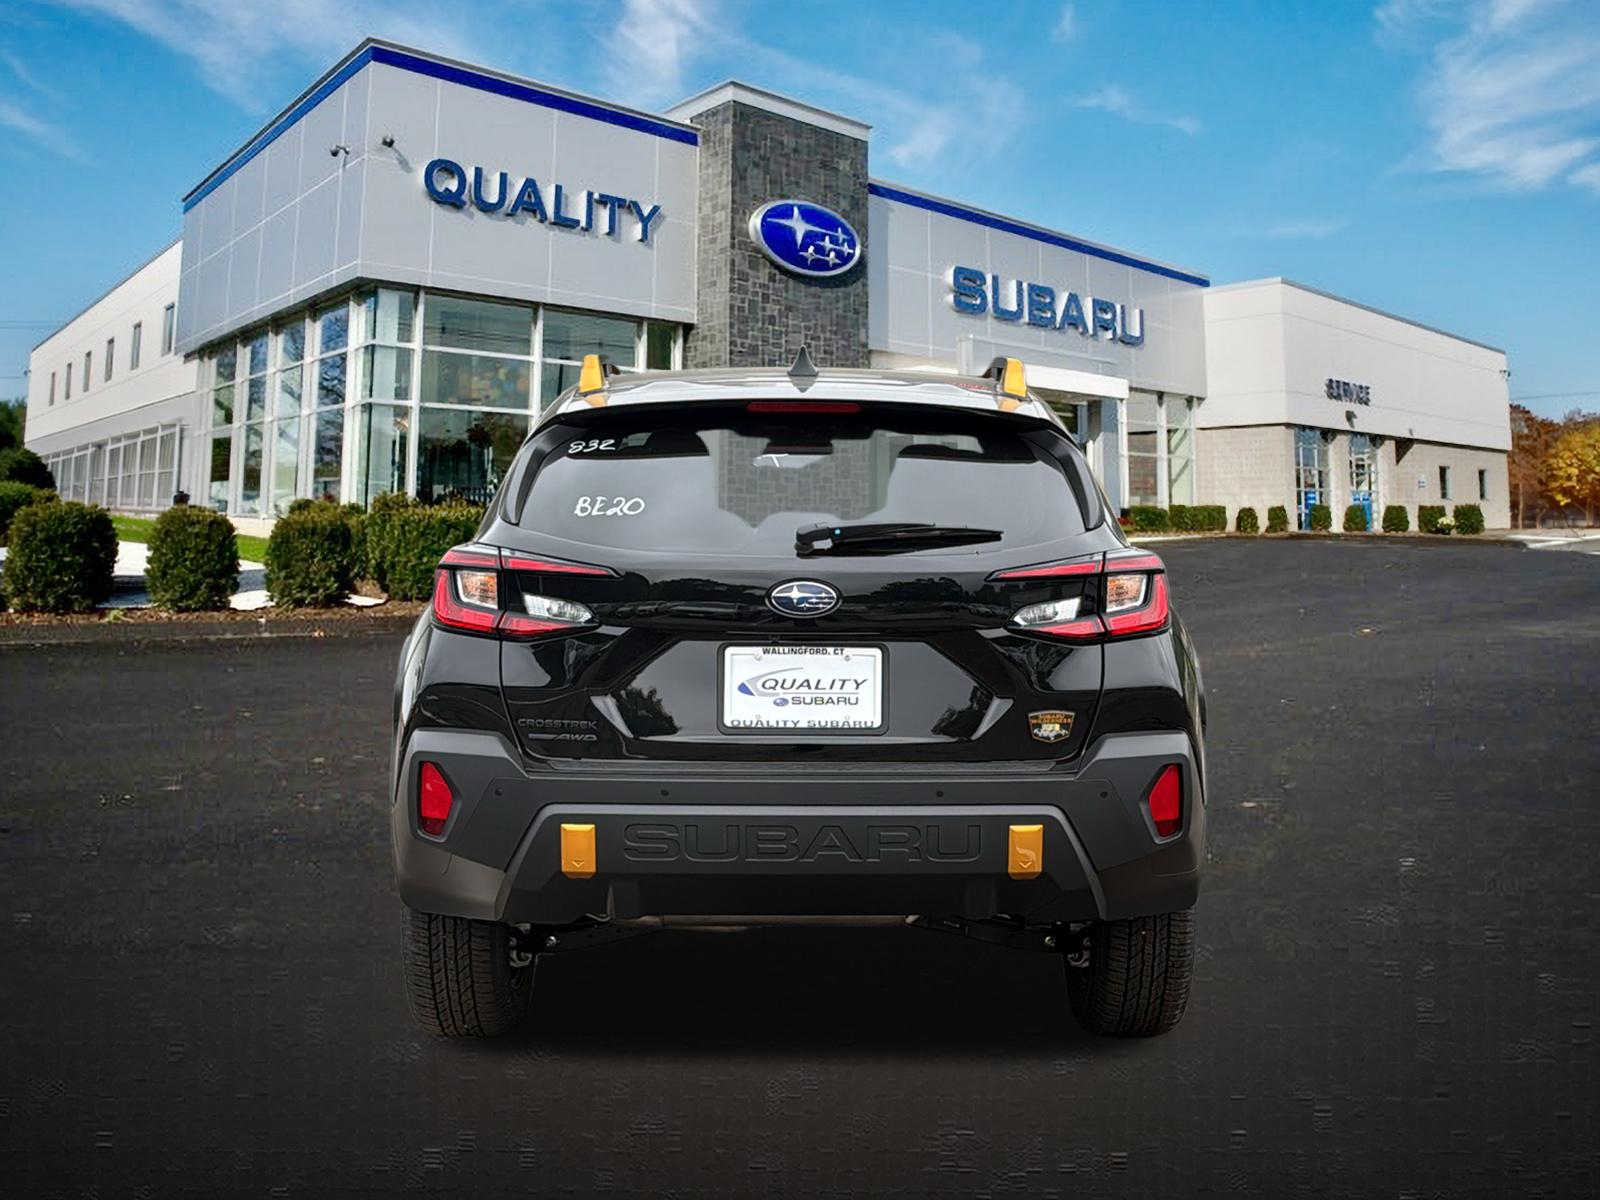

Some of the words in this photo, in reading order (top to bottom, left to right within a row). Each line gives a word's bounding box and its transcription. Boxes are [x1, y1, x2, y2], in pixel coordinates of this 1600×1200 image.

[424, 158, 662, 243] QUALITY
[949, 265, 1145, 346] SUBARU
[568, 439, 616, 454] 832
[574, 496, 645, 517] BE20
[833, 647, 845, 655] CT
[761, 678, 868, 690] QUALITY
[791, 696, 859, 705] SUBARU
[517, 718, 598, 729] CROSSTREK
[730, 719, 801, 728] QUALITY
[806, 719, 875, 728] SUBARU
[555, 733, 598, 742] AWD
[623, 823, 983, 863] SUBARU
